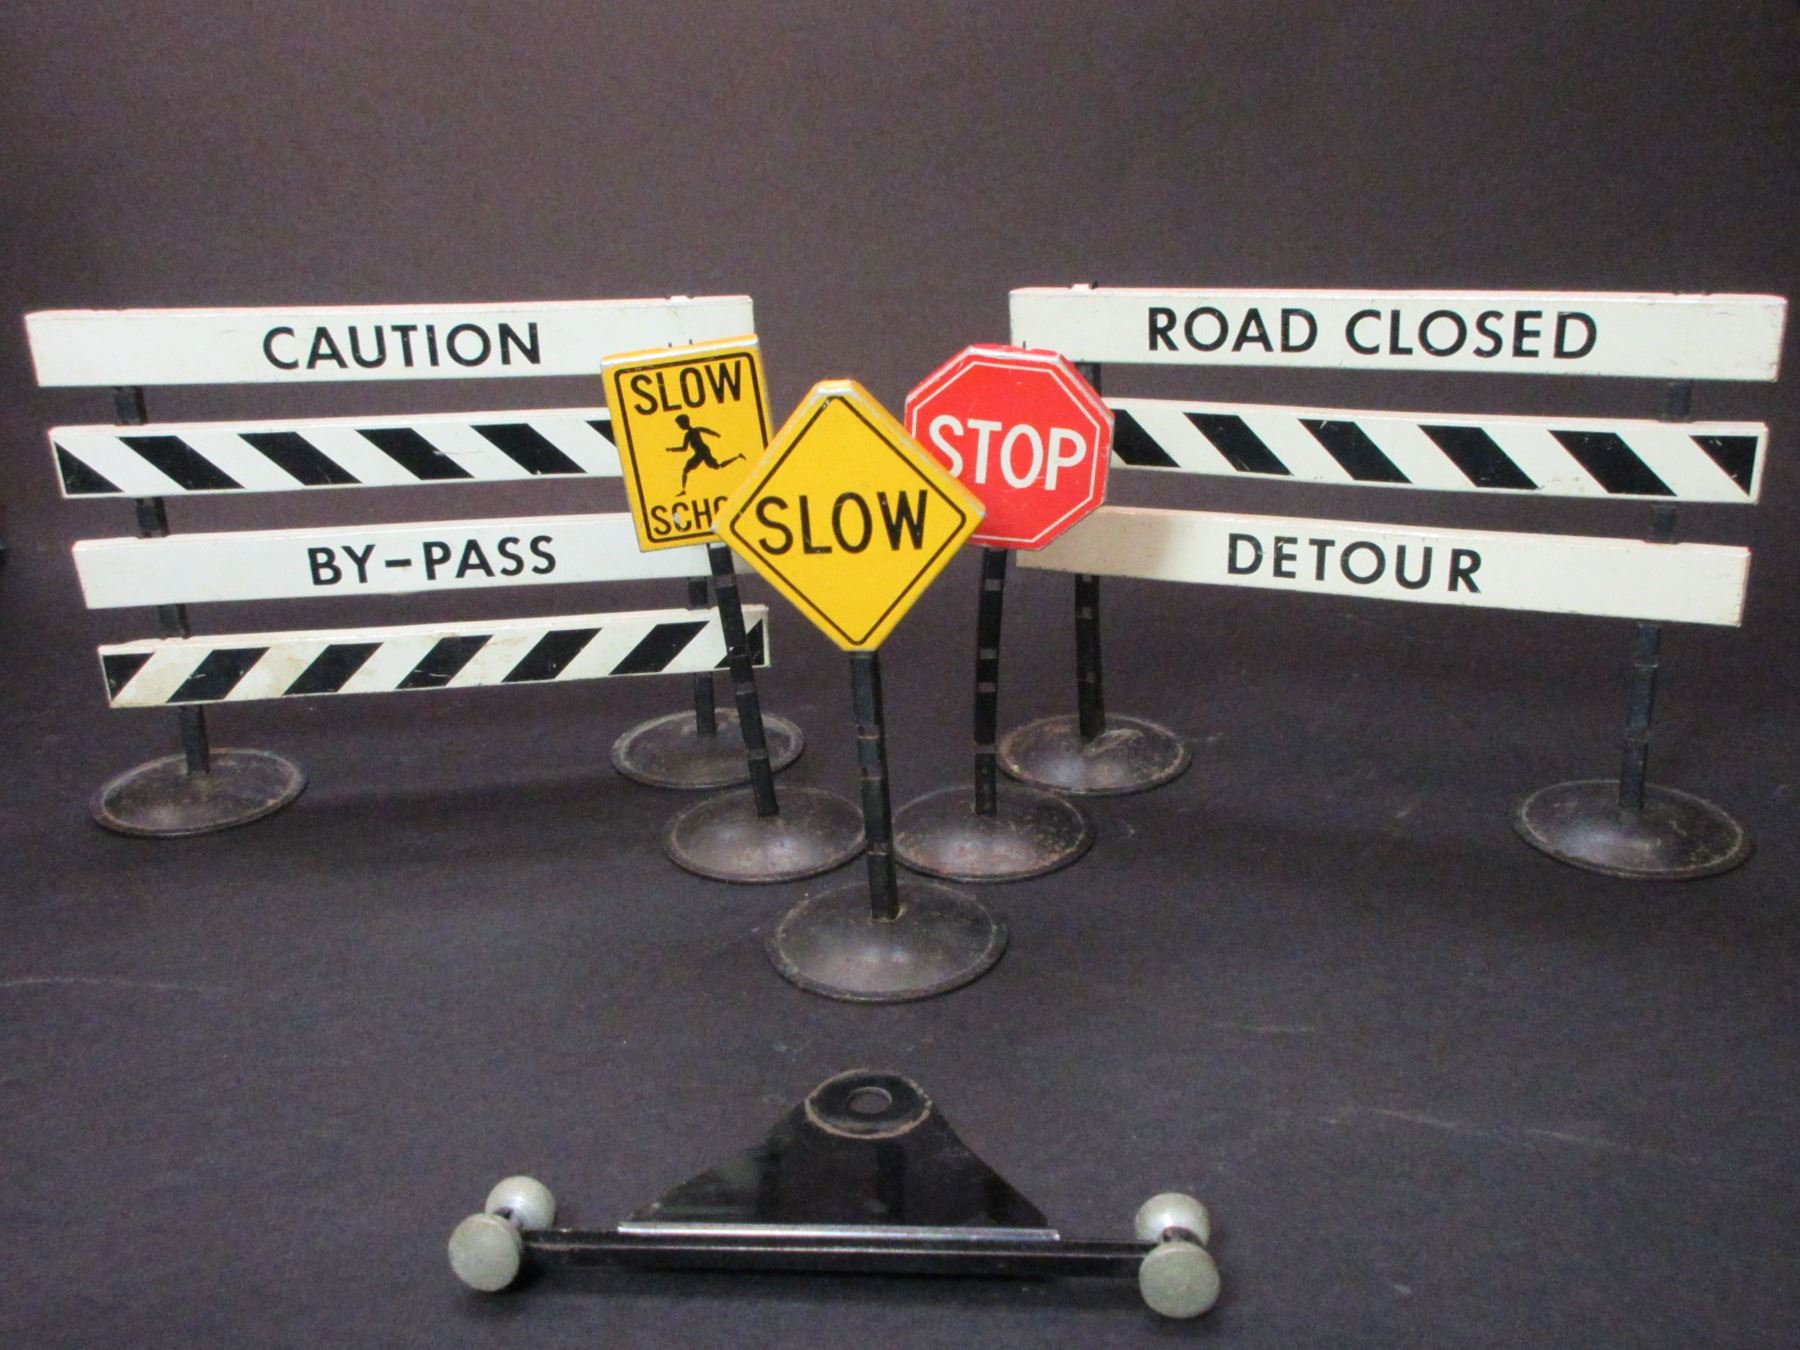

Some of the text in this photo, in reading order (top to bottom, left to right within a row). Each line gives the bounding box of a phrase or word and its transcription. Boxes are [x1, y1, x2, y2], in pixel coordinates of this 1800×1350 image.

[262, 322, 541, 370] CAUTION
[1147, 306, 1598, 360] ROAD CLOSED
[630, 360, 742, 416] SLOW
[928, 414, 1087, 491] STOP
[755, 489, 929, 556] SLOW
[307, 534, 557, 587] BY-PASS
[1227, 532, 1484, 594] DETOUR
